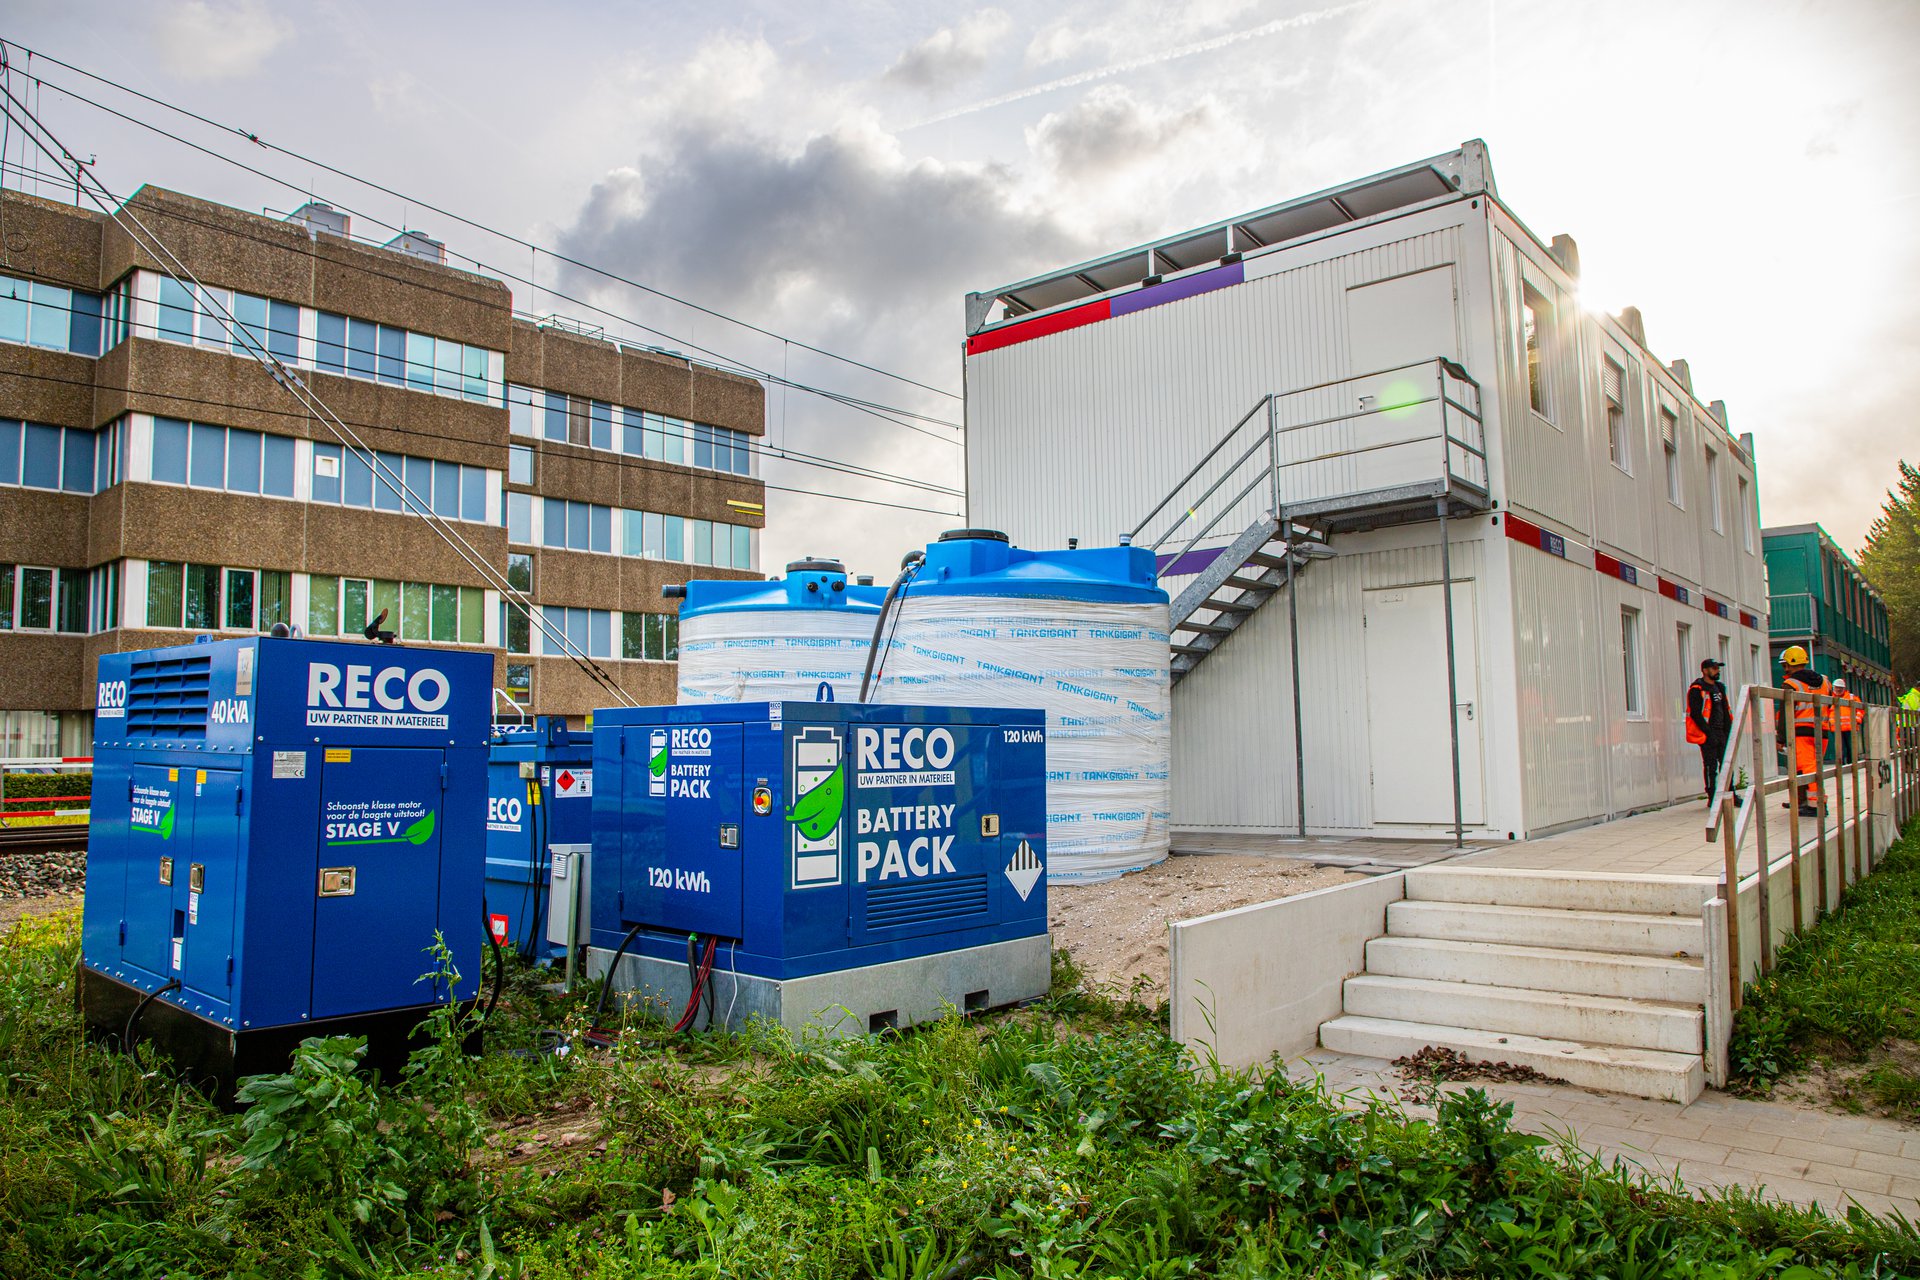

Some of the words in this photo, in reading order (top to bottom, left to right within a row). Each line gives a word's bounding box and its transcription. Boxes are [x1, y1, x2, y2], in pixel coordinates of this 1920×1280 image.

[724, 640, 775, 649] TANKGIGANT
[785, 638, 841, 647] TANKGIGANT
[1010, 629, 1078, 638] TANKGIGANT
[1089, 629, 1142, 640] TANKGIGANT
[796, 671, 852, 679] TANKGIGANT
[912, 645, 966, 665] TANKGIGANT
[976, 660, 1044, 685] TANKGIGANT
[1056, 680, 1119, 705] TANKGIGANT
[98, 681, 126, 708] RECO
[307, 662, 450, 712] RECO
[310, 713, 329, 724] UW
[333, 714, 379, 725] PARTNER
[381, 715, 393, 726] IN
[395, 716, 446, 727] MATERIEEL
[672, 728, 712, 748] RECO
[1004, 730, 1020, 743] 120
[1022, 730, 1043, 743] kWh
[857, 727, 955, 770] RECO
[671, 765, 711, 777] BATTERY
[860, 775, 873, 786] UW
[876, 774, 907, 785] PARTNER
[909, 773, 917, 783] IN
[919, 771, 953, 783] MATERIEEL
[1083, 771, 1139, 780] TANKGIGANT
[671, 779, 711, 799] PACK
[326, 801, 369, 811] Schoonste
[371, 800, 396, 810] klasse
[398, 801, 422, 809] motor
[487, 797, 522, 823] ECO
[131, 807, 153, 825] STAGE
[153, 810, 160, 826] V
[348, 811, 360, 819] de
[361, 811, 391, 821] laagste
[394, 809, 425, 818] uitstoot!
[857, 803, 956, 834] BATTERY
[1092, 811, 1145, 821] TANKGIGANT
[325, 822, 382, 839] STAGE
[387, 821, 400, 836] V
[857, 835, 957, 883] PACK
[648, 867, 672, 889] 120
[675, 868, 711, 893] kWh
